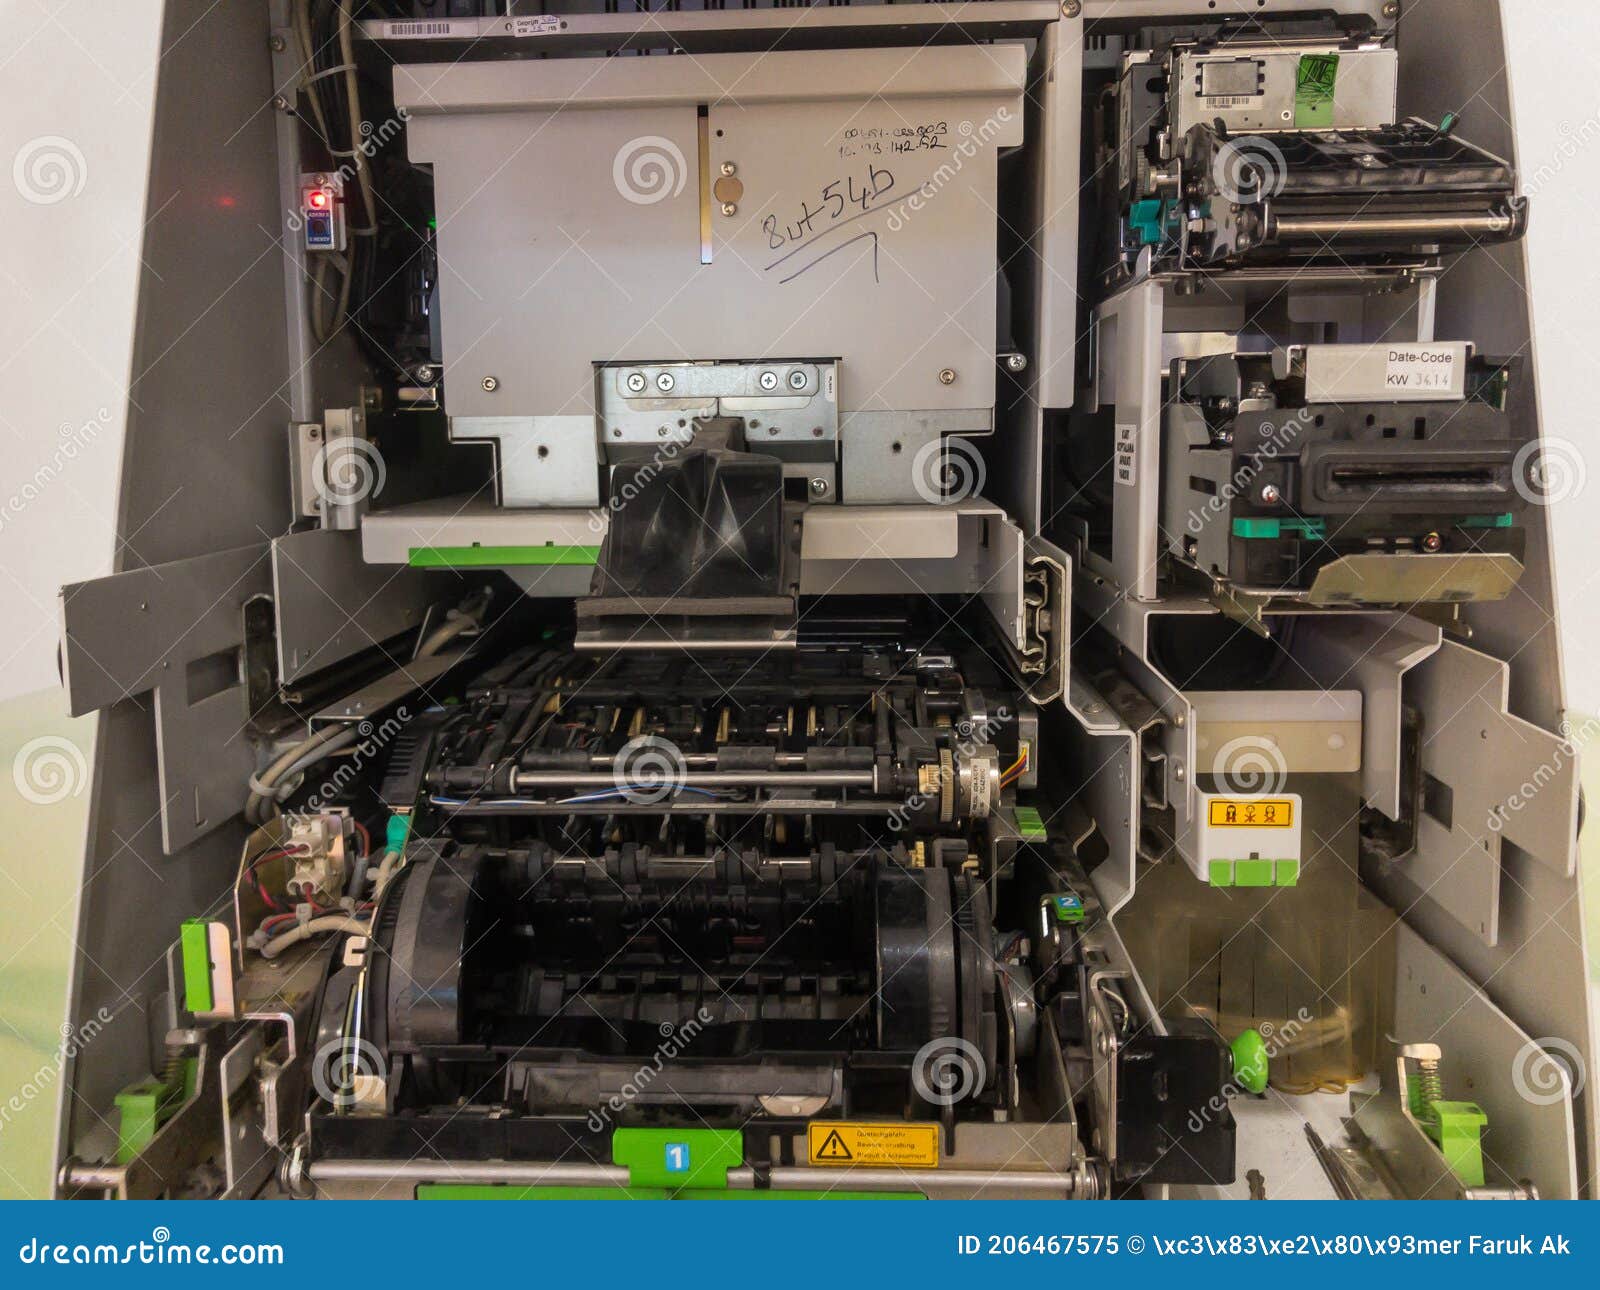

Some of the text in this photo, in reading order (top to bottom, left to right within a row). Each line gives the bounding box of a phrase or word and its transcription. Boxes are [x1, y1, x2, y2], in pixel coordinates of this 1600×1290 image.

[1388, 351, 1452, 363] Date-Code
[1387, 374, 1409, 385] KW
[1061, 897, 1077, 906] 2
[670, 1146, 683, 1169] 1
